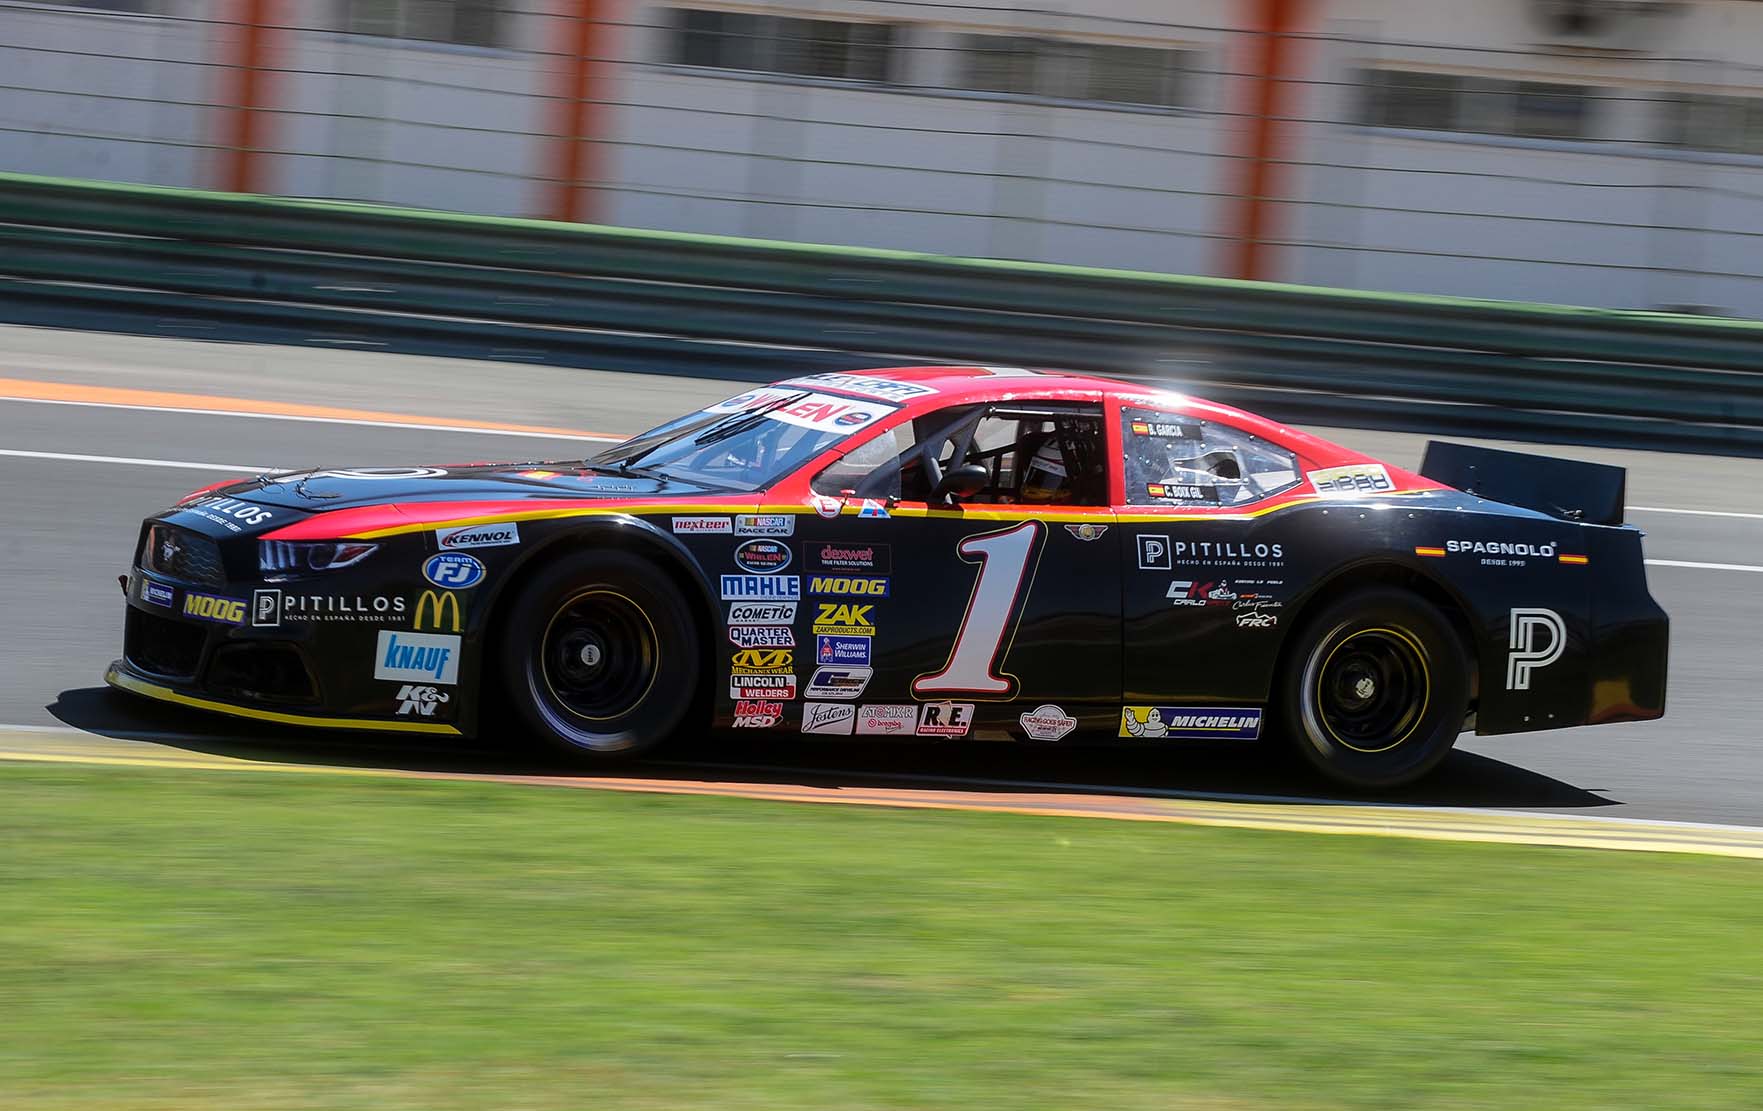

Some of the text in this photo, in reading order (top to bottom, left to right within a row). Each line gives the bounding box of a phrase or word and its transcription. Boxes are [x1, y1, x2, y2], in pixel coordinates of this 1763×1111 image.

[1147, 424, 1184, 437] B. GARCIA
[1164, 485, 1173, 497] C.
[675, 520, 729, 531] nexteer
[756, 517, 786, 527] NASCAR
[448, 531, 512, 544] KENNOL
[821, 545, 874, 560] dexwet
[1176, 542, 1284, 558] PITILLOS
[1446, 541, 1555, 557] SPAGNOLO
[433, 562, 472, 583] FJ
[722, 577, 799, 596] MAHLE
[810, 577, 887, 595] MOOG
[182, 594, 247, 623] MOOG
[284, 596, 406, 612] PITILLOS
[913, 520, 1039, 693] 1
[732, 607, 794, 620] COMETIC
[814, 604, 874, 625] ZAK
[731, 627, 789, 640] QUARTER
[741, 636, 792, 646] MASTER
[835, 641, 867, 651] SHERWIN
[384, 634, 451, 680] KNAUF
[731, 666, 770, 674] MECHANIX
[734, 677, 785, 688] LINCOLN
[745, 689, 789, 698] WELDERS
[735, 701, 784, 718] Holley
[732, 716, 775, 728] MSD
[803, 704, 851, 731] Jostens
[1171, 716, 1260, 728] MICHELIN
